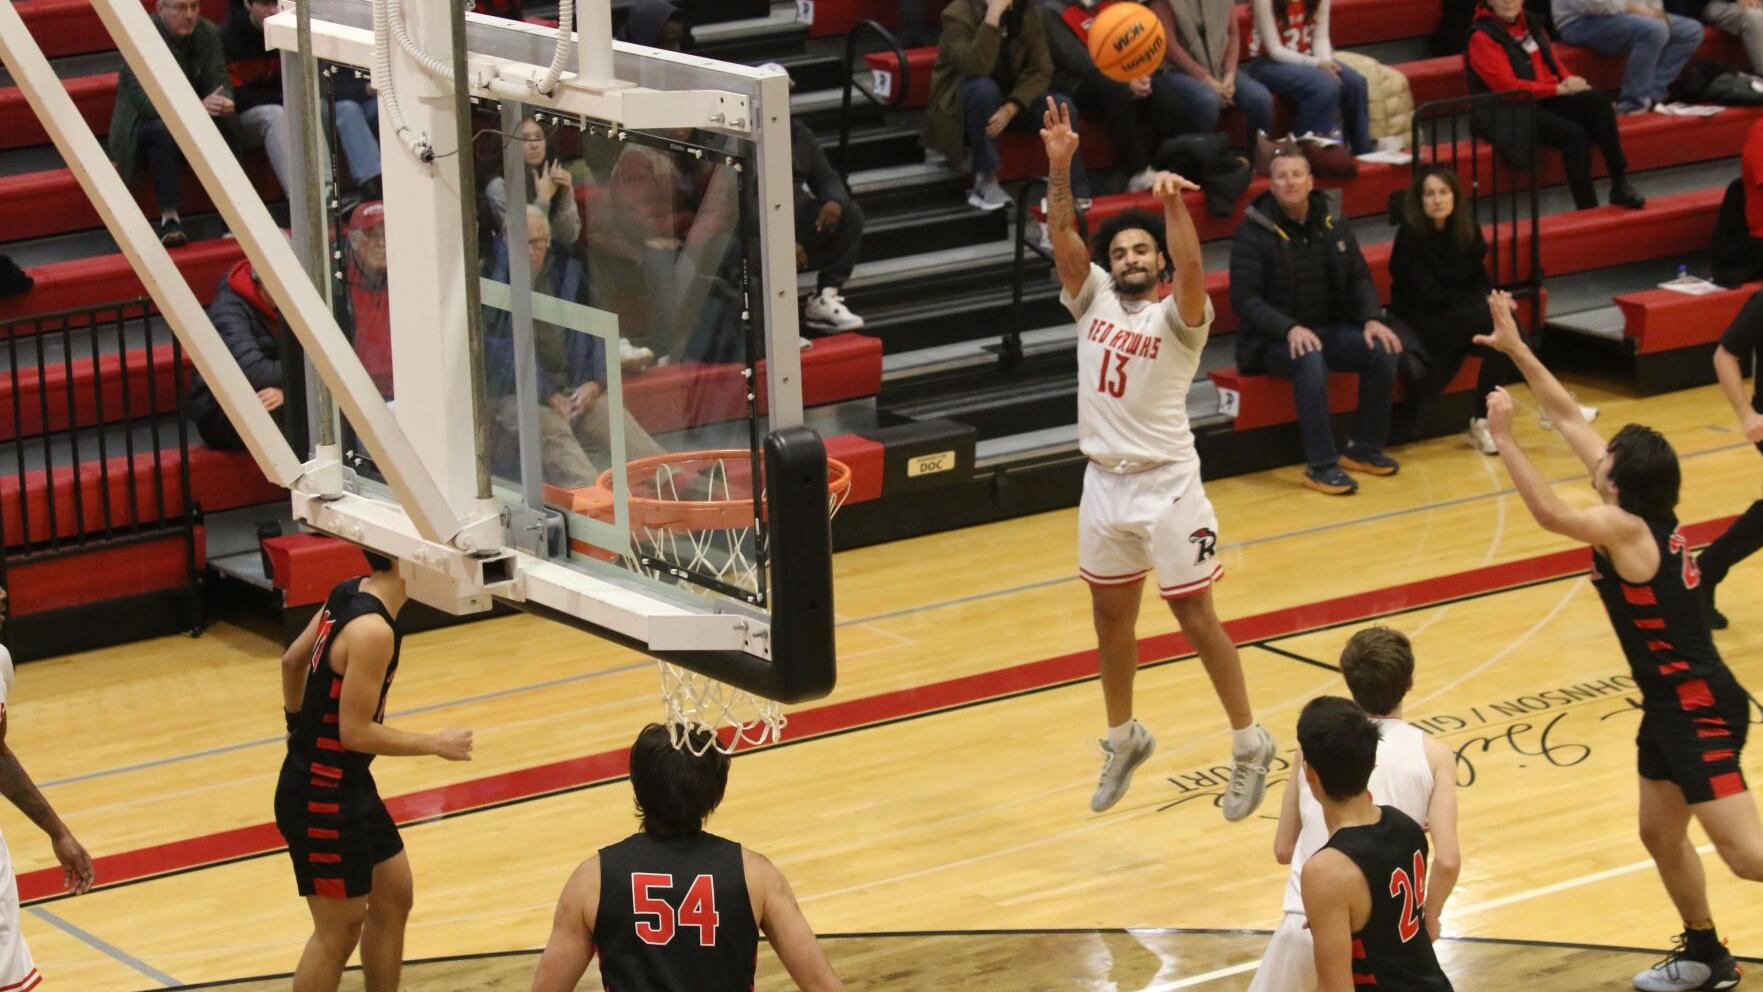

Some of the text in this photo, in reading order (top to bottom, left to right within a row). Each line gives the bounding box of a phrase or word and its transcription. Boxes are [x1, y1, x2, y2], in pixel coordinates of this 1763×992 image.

[1088, 318, 1115, 343] RED
[1098, 348, 1130, 399] 13
[919, 459, 944, 473] DOC
[1488, 675, 1641, 717] OHNSON
[1167, 757, 1290, 793] CURT
[631, 872, 720, 947] 54
